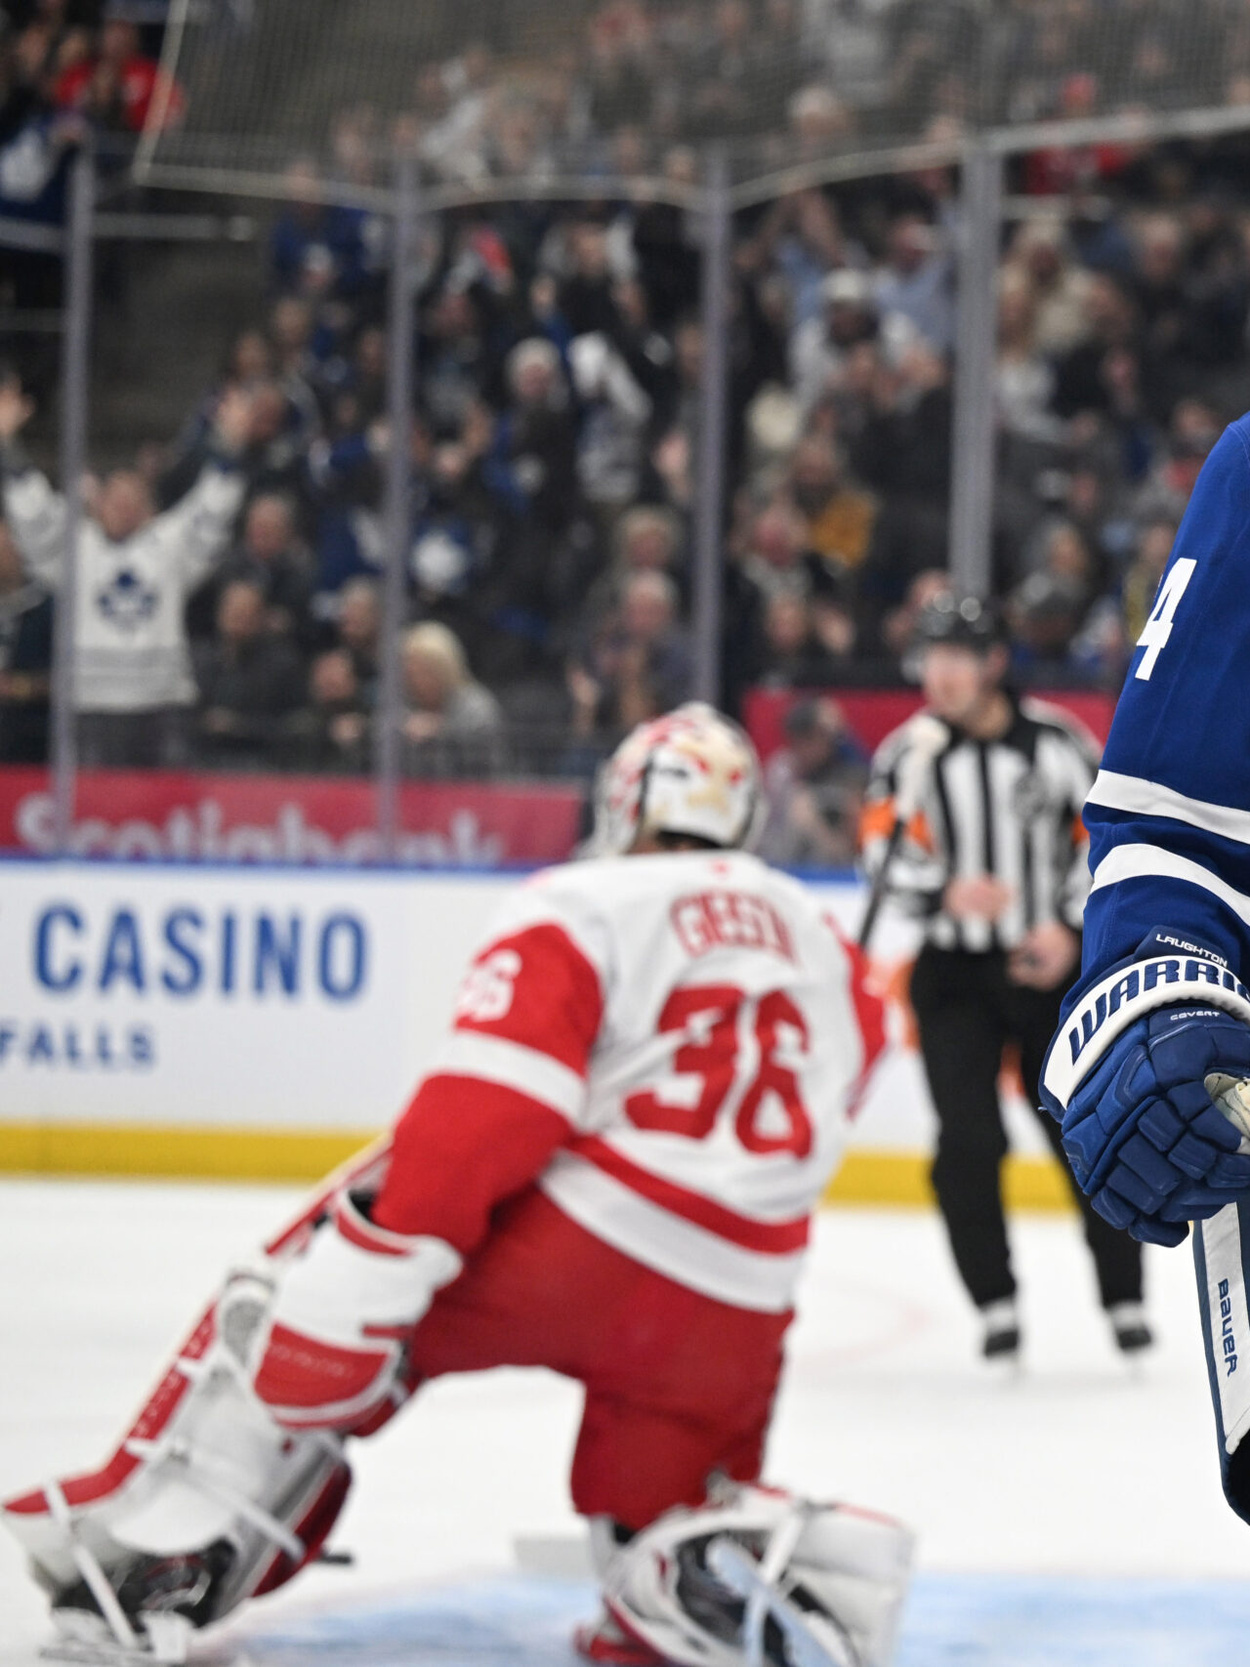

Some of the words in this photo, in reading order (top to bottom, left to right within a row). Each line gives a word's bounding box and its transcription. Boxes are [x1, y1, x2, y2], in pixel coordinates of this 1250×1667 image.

[33, 902, 370, 1003] CASINO
[1155, 933, 1228, 968] LAUGHTON
[1169, 1009, 1221, 1022] COVERT
[624, 980, 814, 1159] 36
[1217, 1277, 1239, 1378] BAUER
